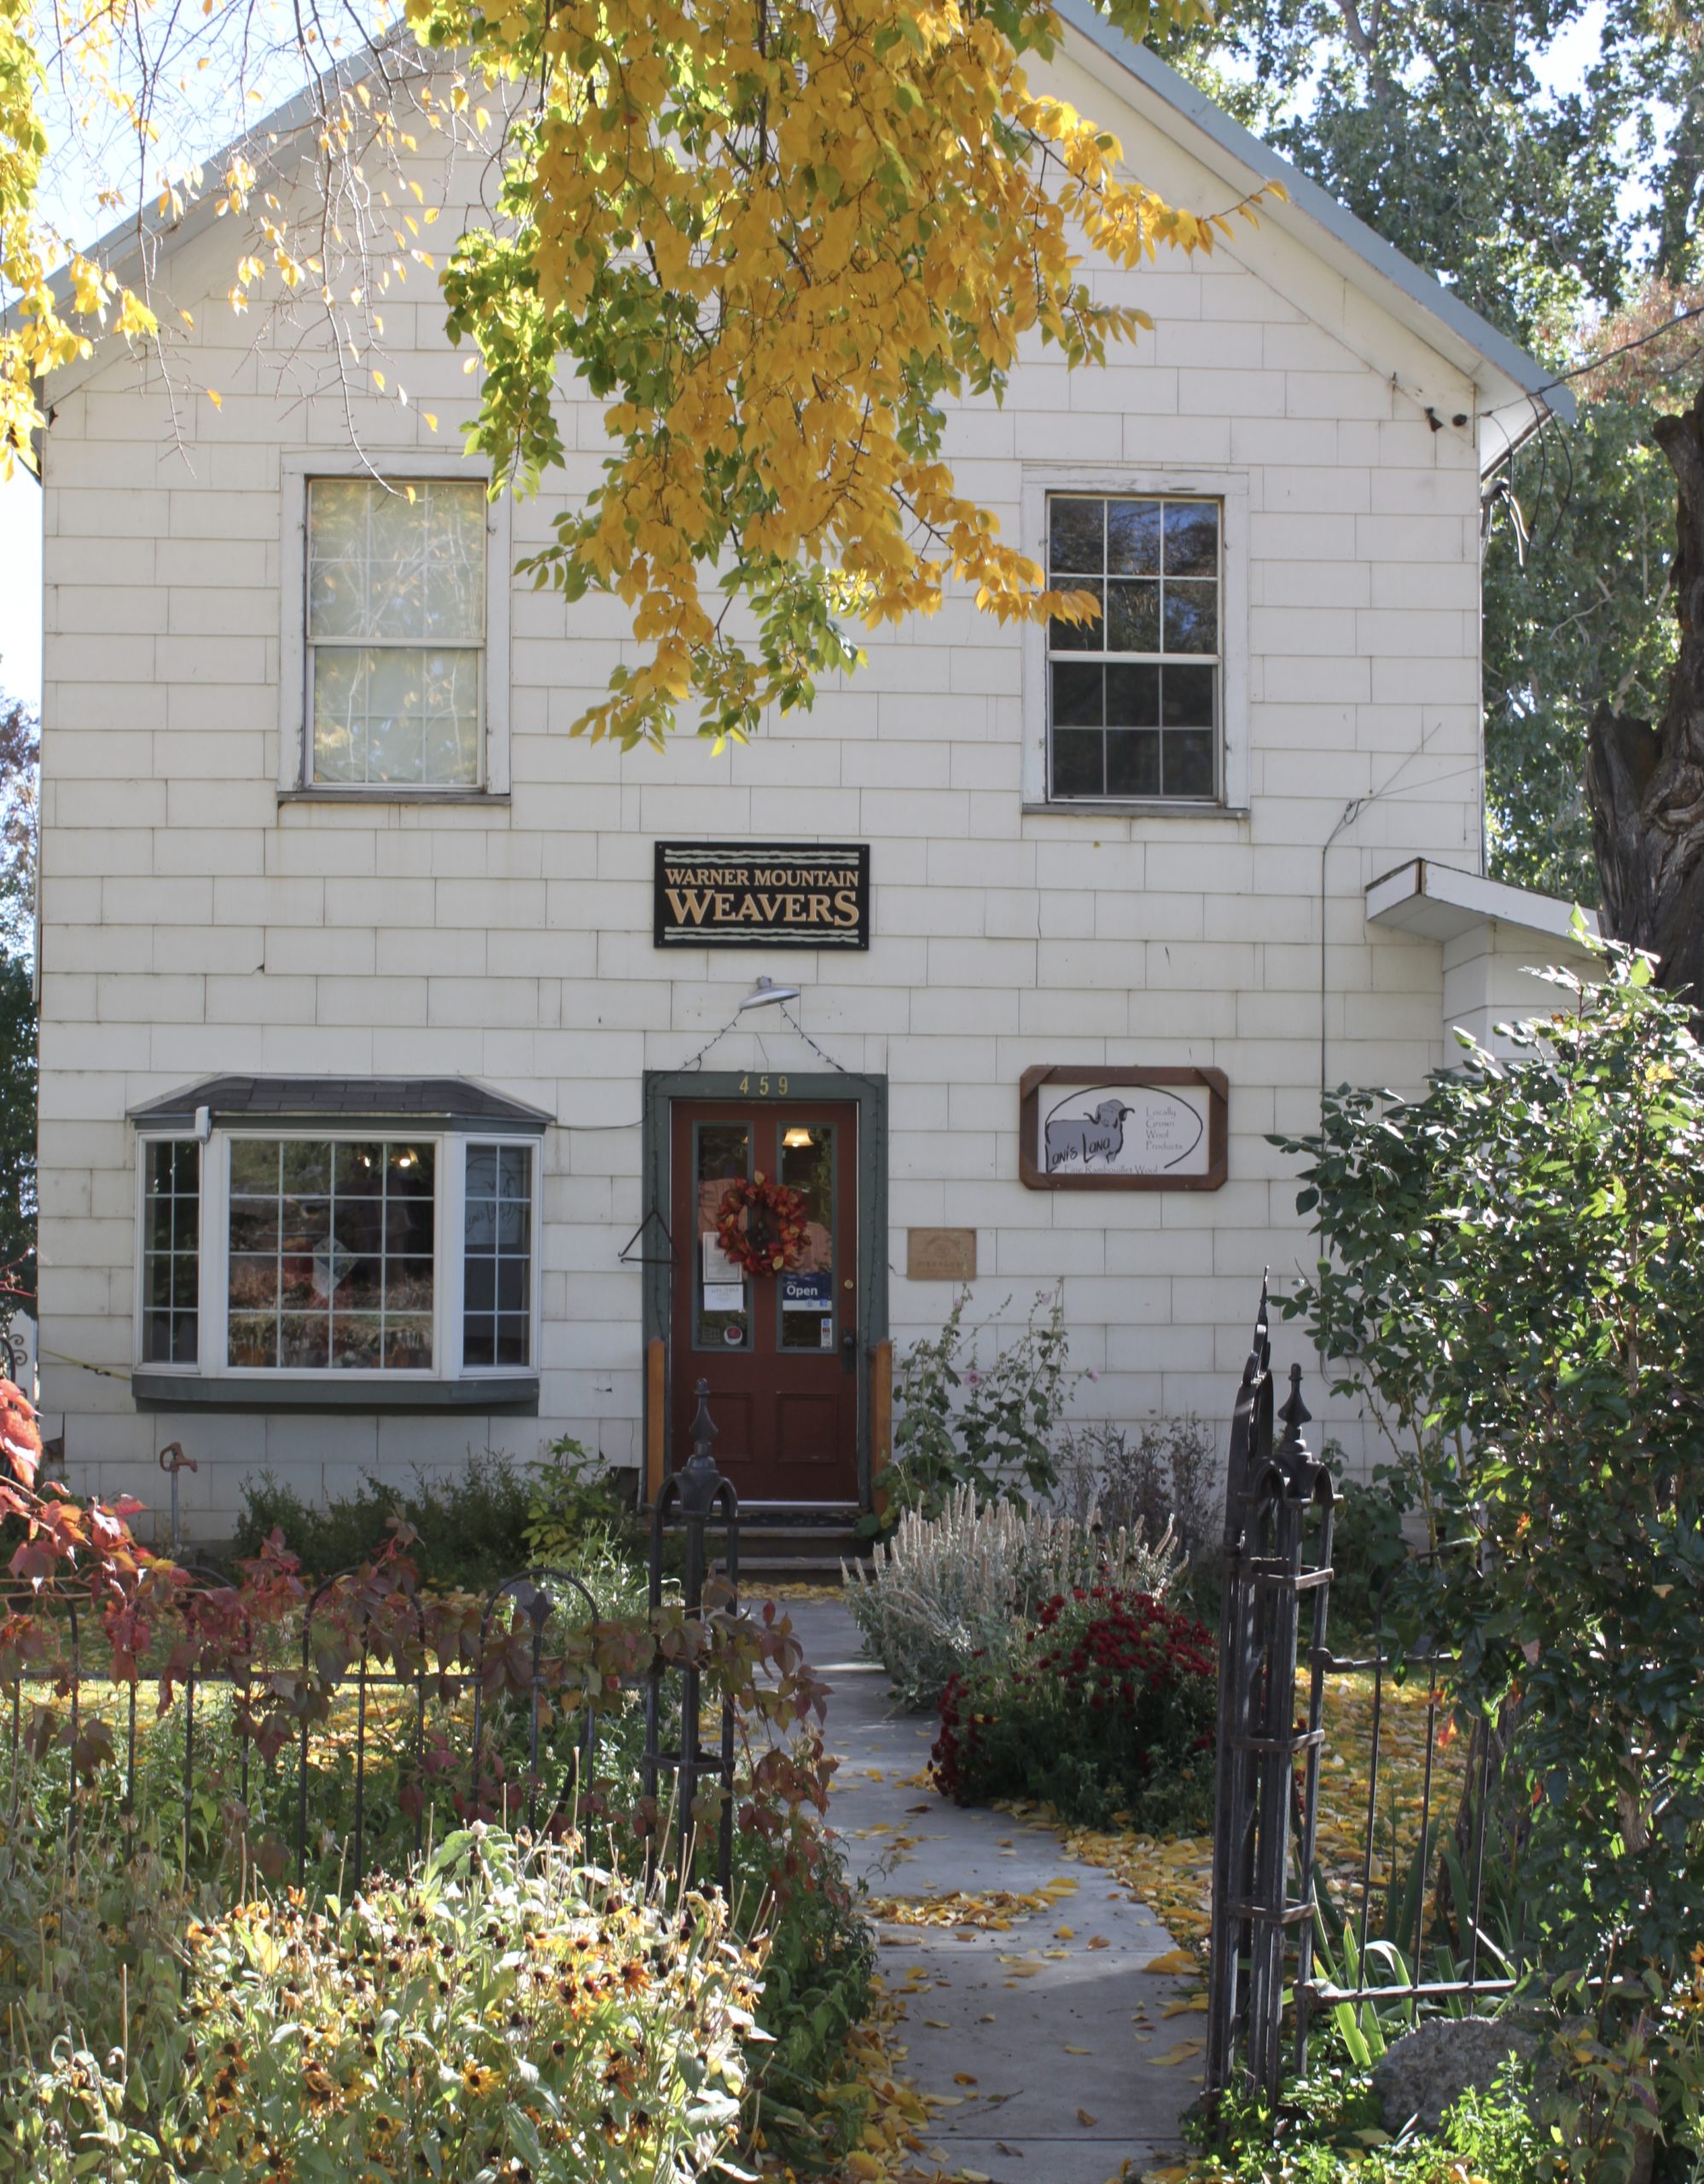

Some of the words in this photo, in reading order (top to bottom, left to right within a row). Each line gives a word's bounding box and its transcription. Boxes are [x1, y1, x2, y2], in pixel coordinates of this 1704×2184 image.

[665, 868, 750, 886] WARNER
[754, 869, 858, 887] MOUNTAIN
[665, 888, 859, 926] WEAVERS
[739, 1075, 788, 1095] 459
[1146, 1106, 1177, 1118] Locally
[1145, 1118, 1175, 1128] Grown
[1145, 1129, 1169, 1139] Wool
[1146, 1140, 1183, 1151] Products
[786, 1284, 818, 1298] Open
